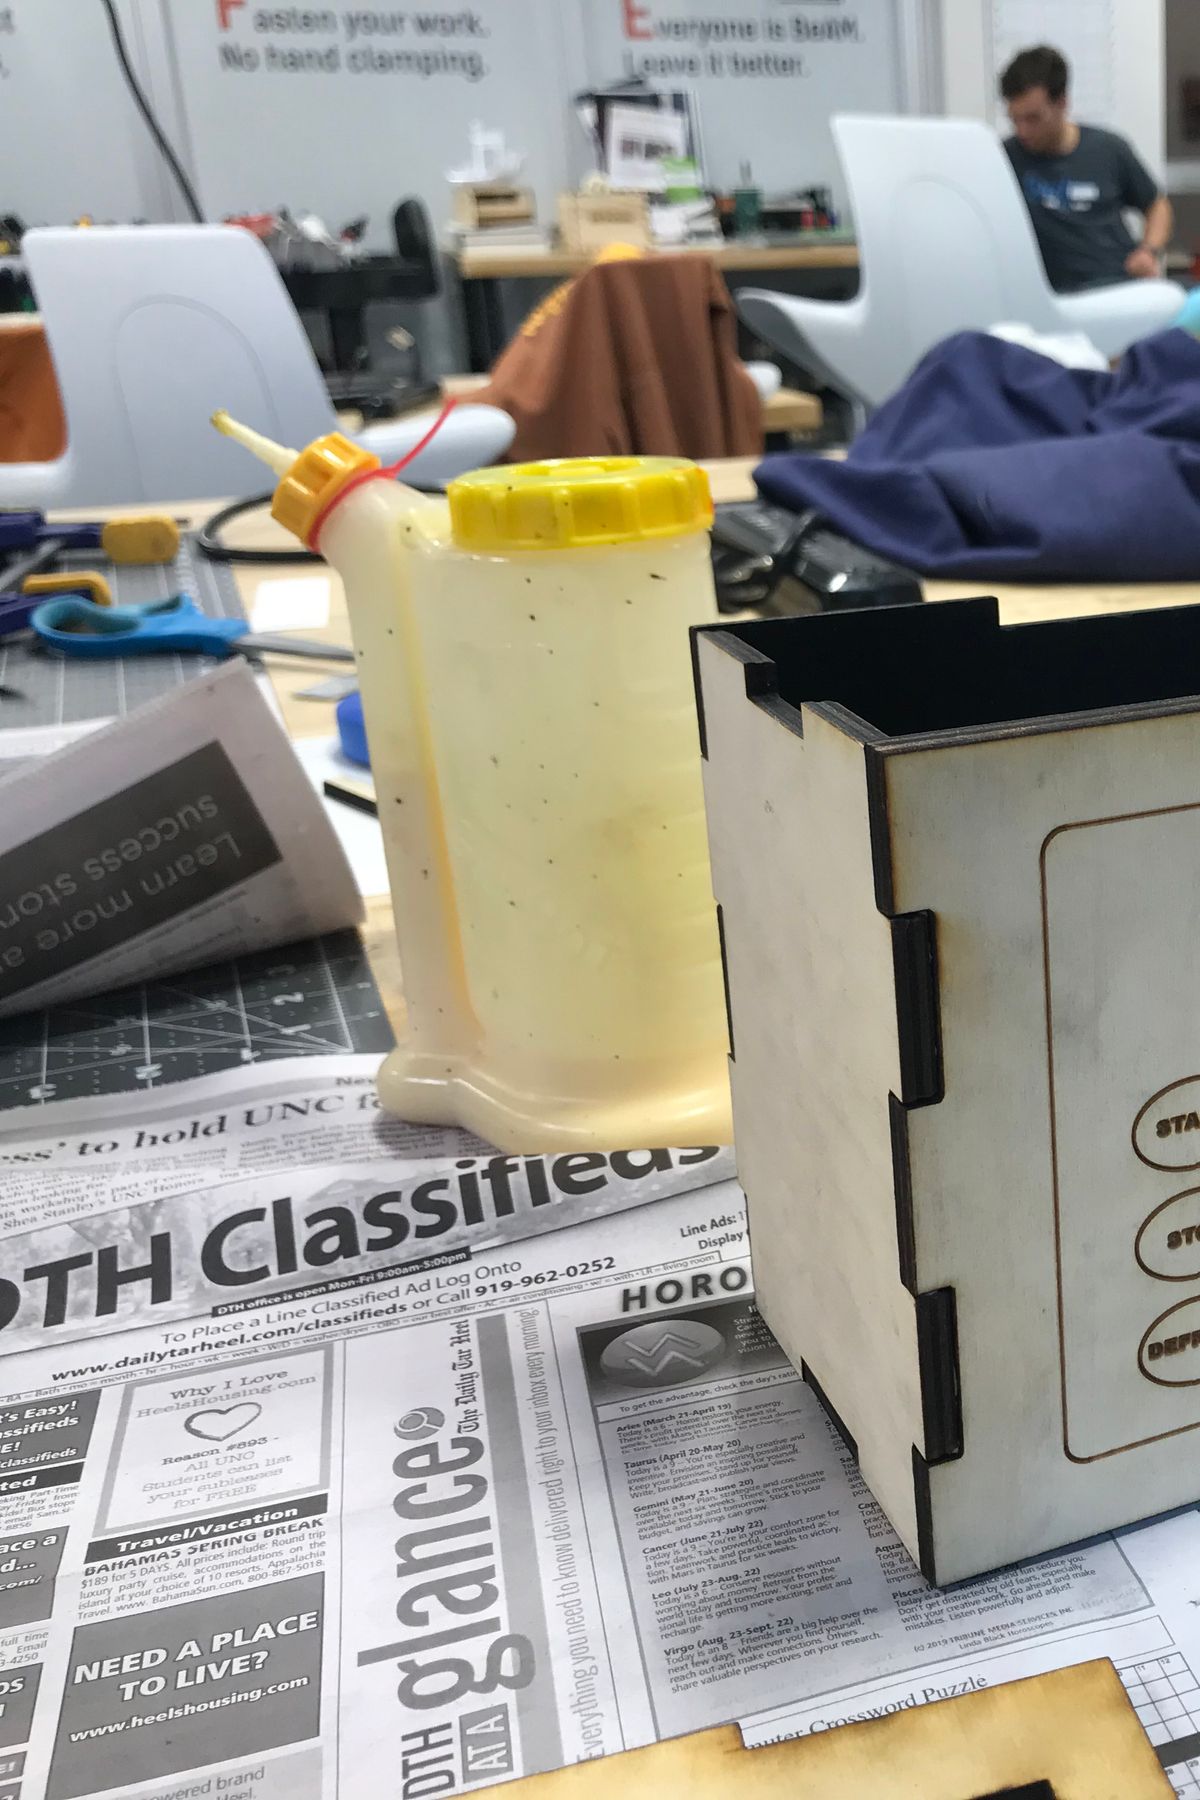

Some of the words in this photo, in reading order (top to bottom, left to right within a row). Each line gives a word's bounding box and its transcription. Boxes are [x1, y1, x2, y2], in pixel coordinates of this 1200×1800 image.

[343, 9, 405, 42] your
[412, 9, 491, 38] work.
[218, 43, 260, 72] No
[265, 44, 341, 73] hand
[347, 45, 489, 83] clamping.
[622, 47, 699, 78] Leave
[83, 794, 219, 882] success
[139, 832, 242, 896] Learn
[35, 889, 134, 951] more
[77, 1140, 120, 1156] to
[134, 1115, 227, 1149] hold
[244, 1093, 346, 1127] UNC
[680, 1221, 707, 1237] Line
[708, 1212, 736, 1229] Ads:
[698, 1229, 743, 1252] Display
[162, 1330, 186, 1345] To
[191, 1317, 245, 1339] Place
[248, 1318, 261, 1328] a
[266, 1305, 307, 1324] Line
[311, 1286, 399, 1315] Classified
[405, 1279, 430, 1296] Ad
[435, 1272, 471, 1292] Log
[474, 1259, 522, 1281] Onto
[51, 1300, 407, 1382] www.dailytarheel.com/classifieds
[412, 1297, 433, 1310] or
[436, 1287, 471, 1305] Call
[474, 1255, 615, 1296] 919-962-0252
[448, 1319, 471, 1346] Heel
[450, 1349, 473, 1370] Tar
[527, 1350, 547, 1378] every
[170, 1382, 214, 1403] Why
[222, 1380, 231, 1390] I
[239, 1366, 288, 1387] Love
[452, 1371, 480, 1406] Daily
[529, 1378, 550, 1408] inbox
[22, 1400, 78, 1421] Easy!
[455, 1408, 483, 1433] The
[534, 1409, 556, 1434] your
[161, 1446, 220, 1467] Reason
[537, 1435, 556, 1448] to
[538, 1450, 565, 1476] right
[624, 1456, 657, 1469] Taurus
[542, 1478, 571, 1541] delivered
[633, 1498, 668, 1512] Gemini
[116, 1506, 297, 1553] Travel/Vacation
[83, 1548, 181, 1577] BAHAMAS
[185, 1531, 256, 1555] SPRING
[262, 1517, 323, 1538] BREAK
[551, 1542, 577, 1580] know
[642, 1541, 677, 1555] Cancer
[357, 1436, 536, 1710] glance
[555, 1581, 580, 1597] to
[652, 1589, 671, 1599] Leo
[556, 1597, 586, 1636] need
[72, 1646, 167, 1684] NEED
[172, 1638, 201, 1661] A
[208, 1610, 319, 1652] PLACE
[567, 1635, 591, 1666] you
[664, 1642, 694, 1657] Virgo
[120, 1674, 166, 1702] TO
[172, 1650, 270, 1690] LIVE?
[69, 1675, 309, 1742] www.heelshousing.com
[808, 1693, 917, 1734] Crossword
[921, 1674, 989, 1704] Puzzle
[465, 1713, 506, 1738] A
[401, 1722, 456, 1800] DTH
[466, 1744, 509, 1778] AT
[214, 1766, 265, 1790] brand
